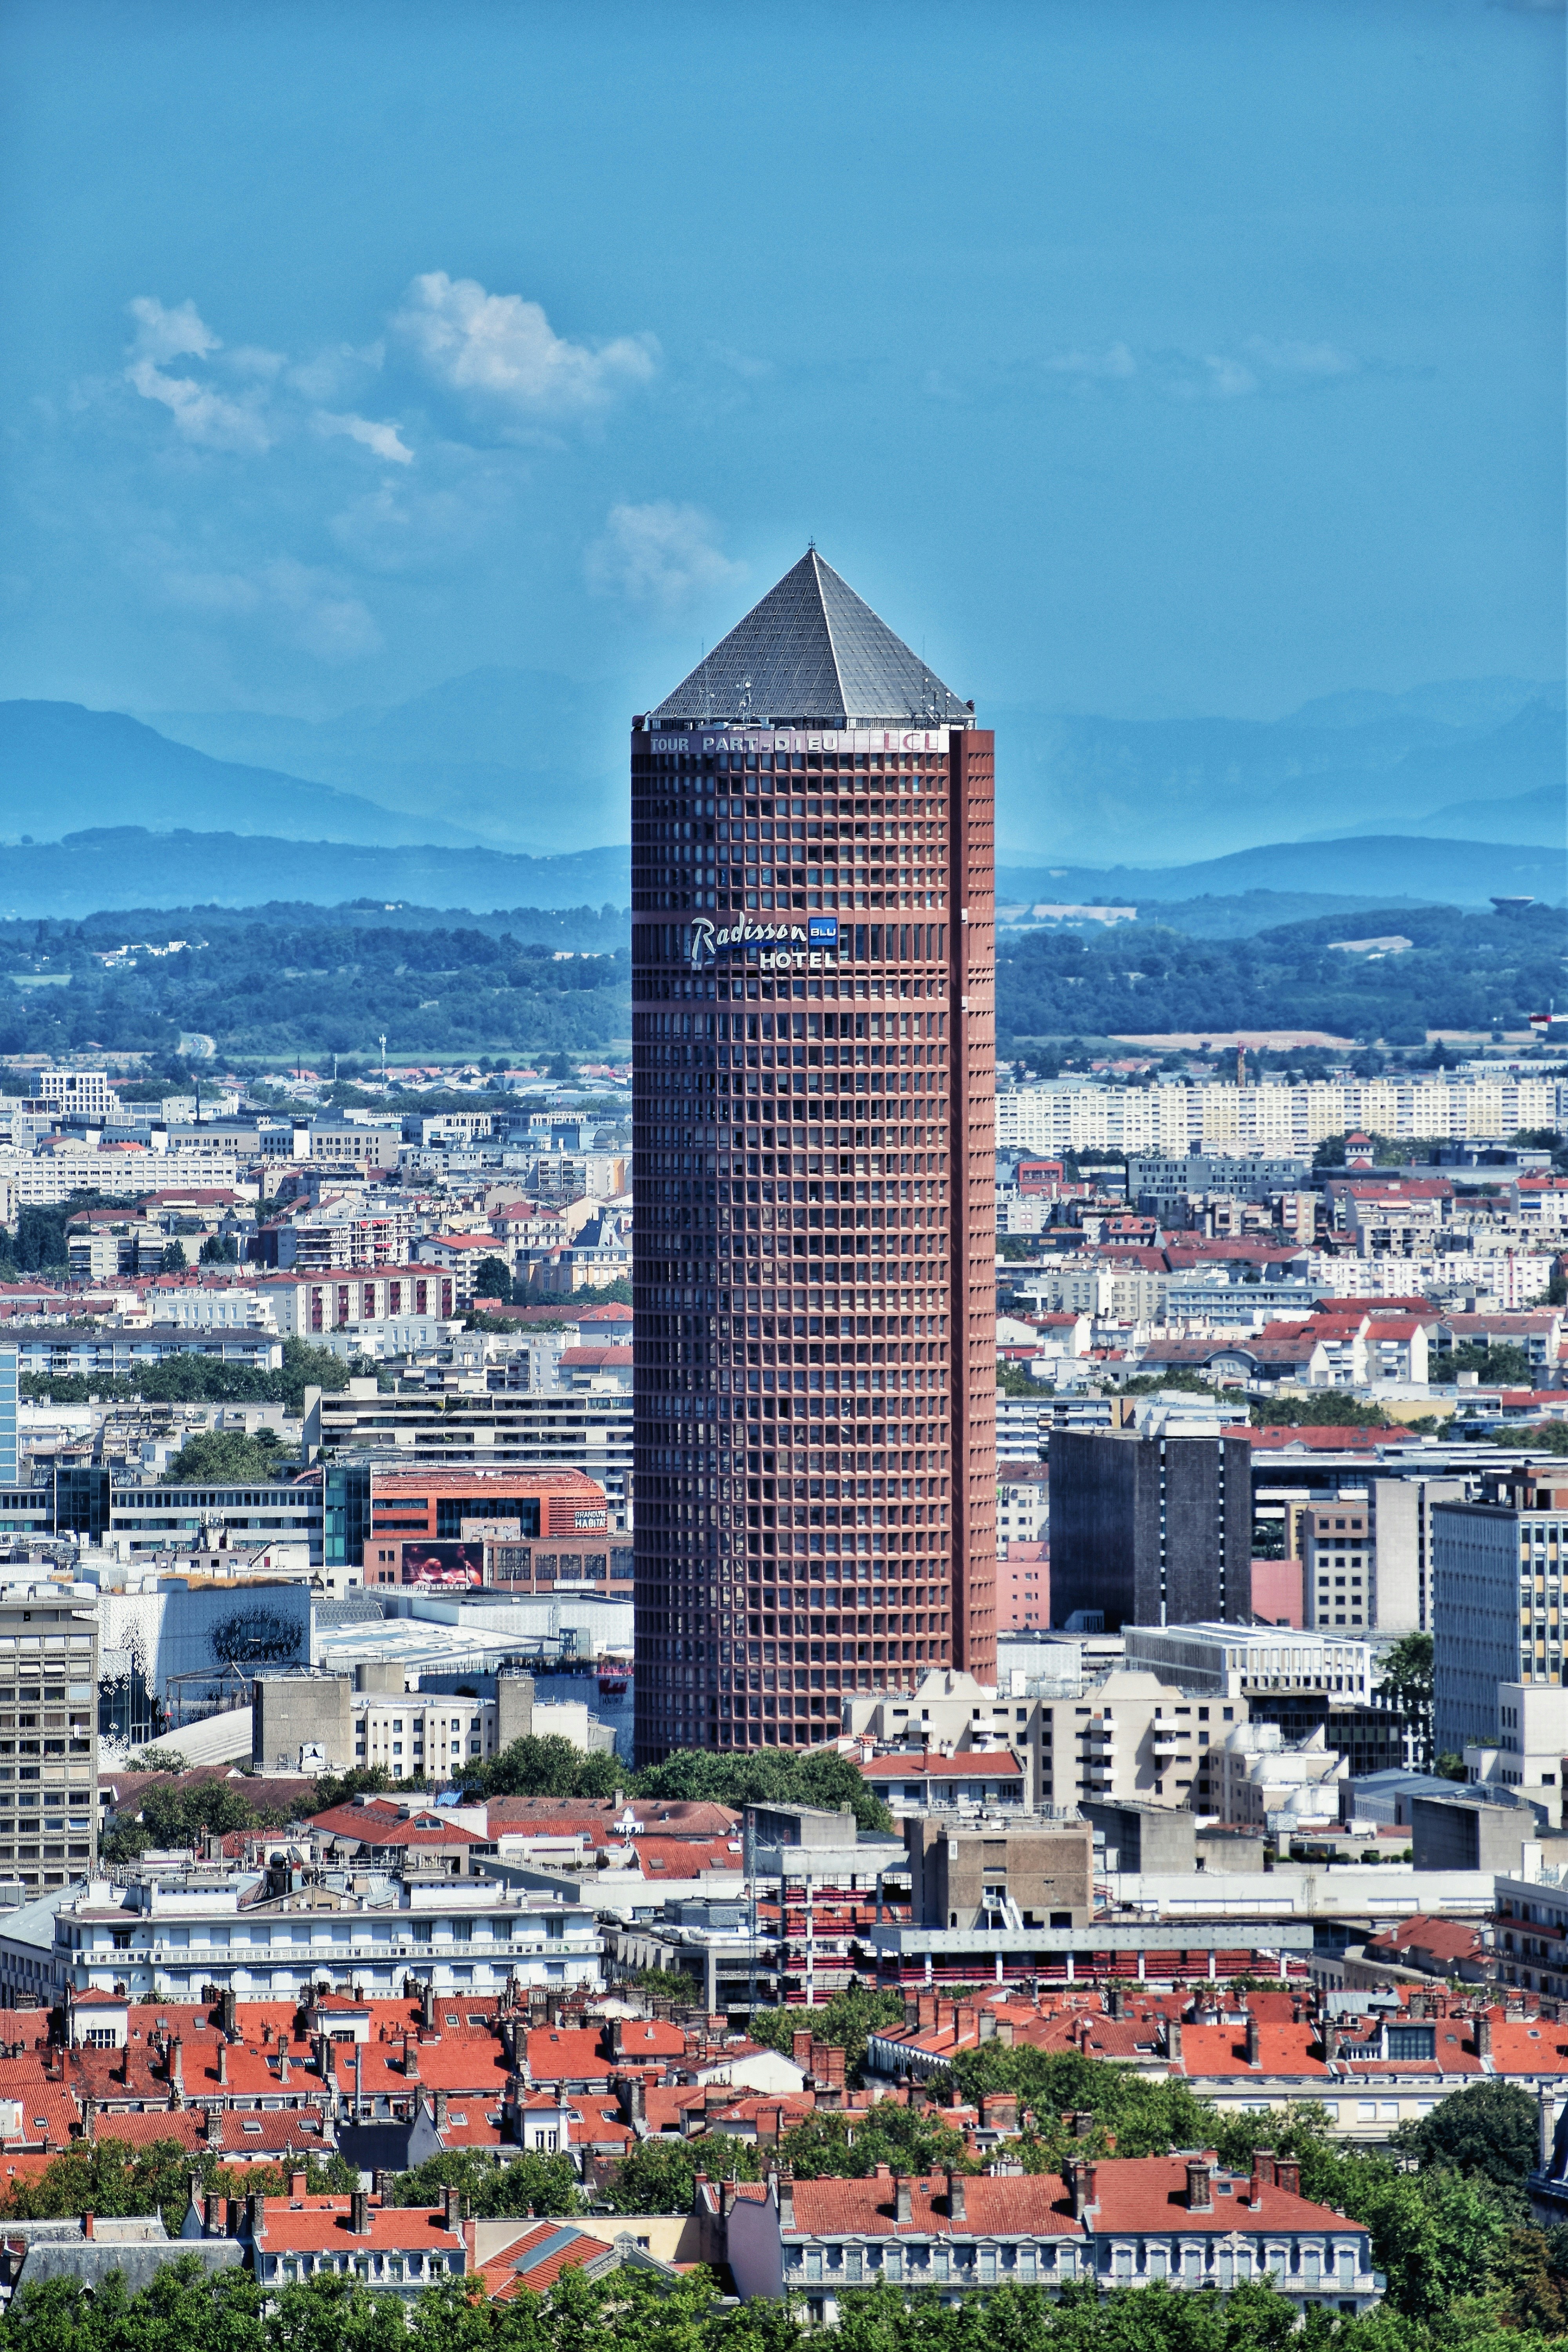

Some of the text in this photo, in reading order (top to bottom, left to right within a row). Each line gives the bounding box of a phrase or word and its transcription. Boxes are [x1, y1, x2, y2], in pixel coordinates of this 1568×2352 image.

[651, 737, 838, 751] TOUR PART-DIEU
[884, 733, 938, 751] LCL
[691, 911, 836, 960] Radisson BLU
[760, 953, 837, 969] HOTEL
[575, 1518, 606, 1528] HABITAT
